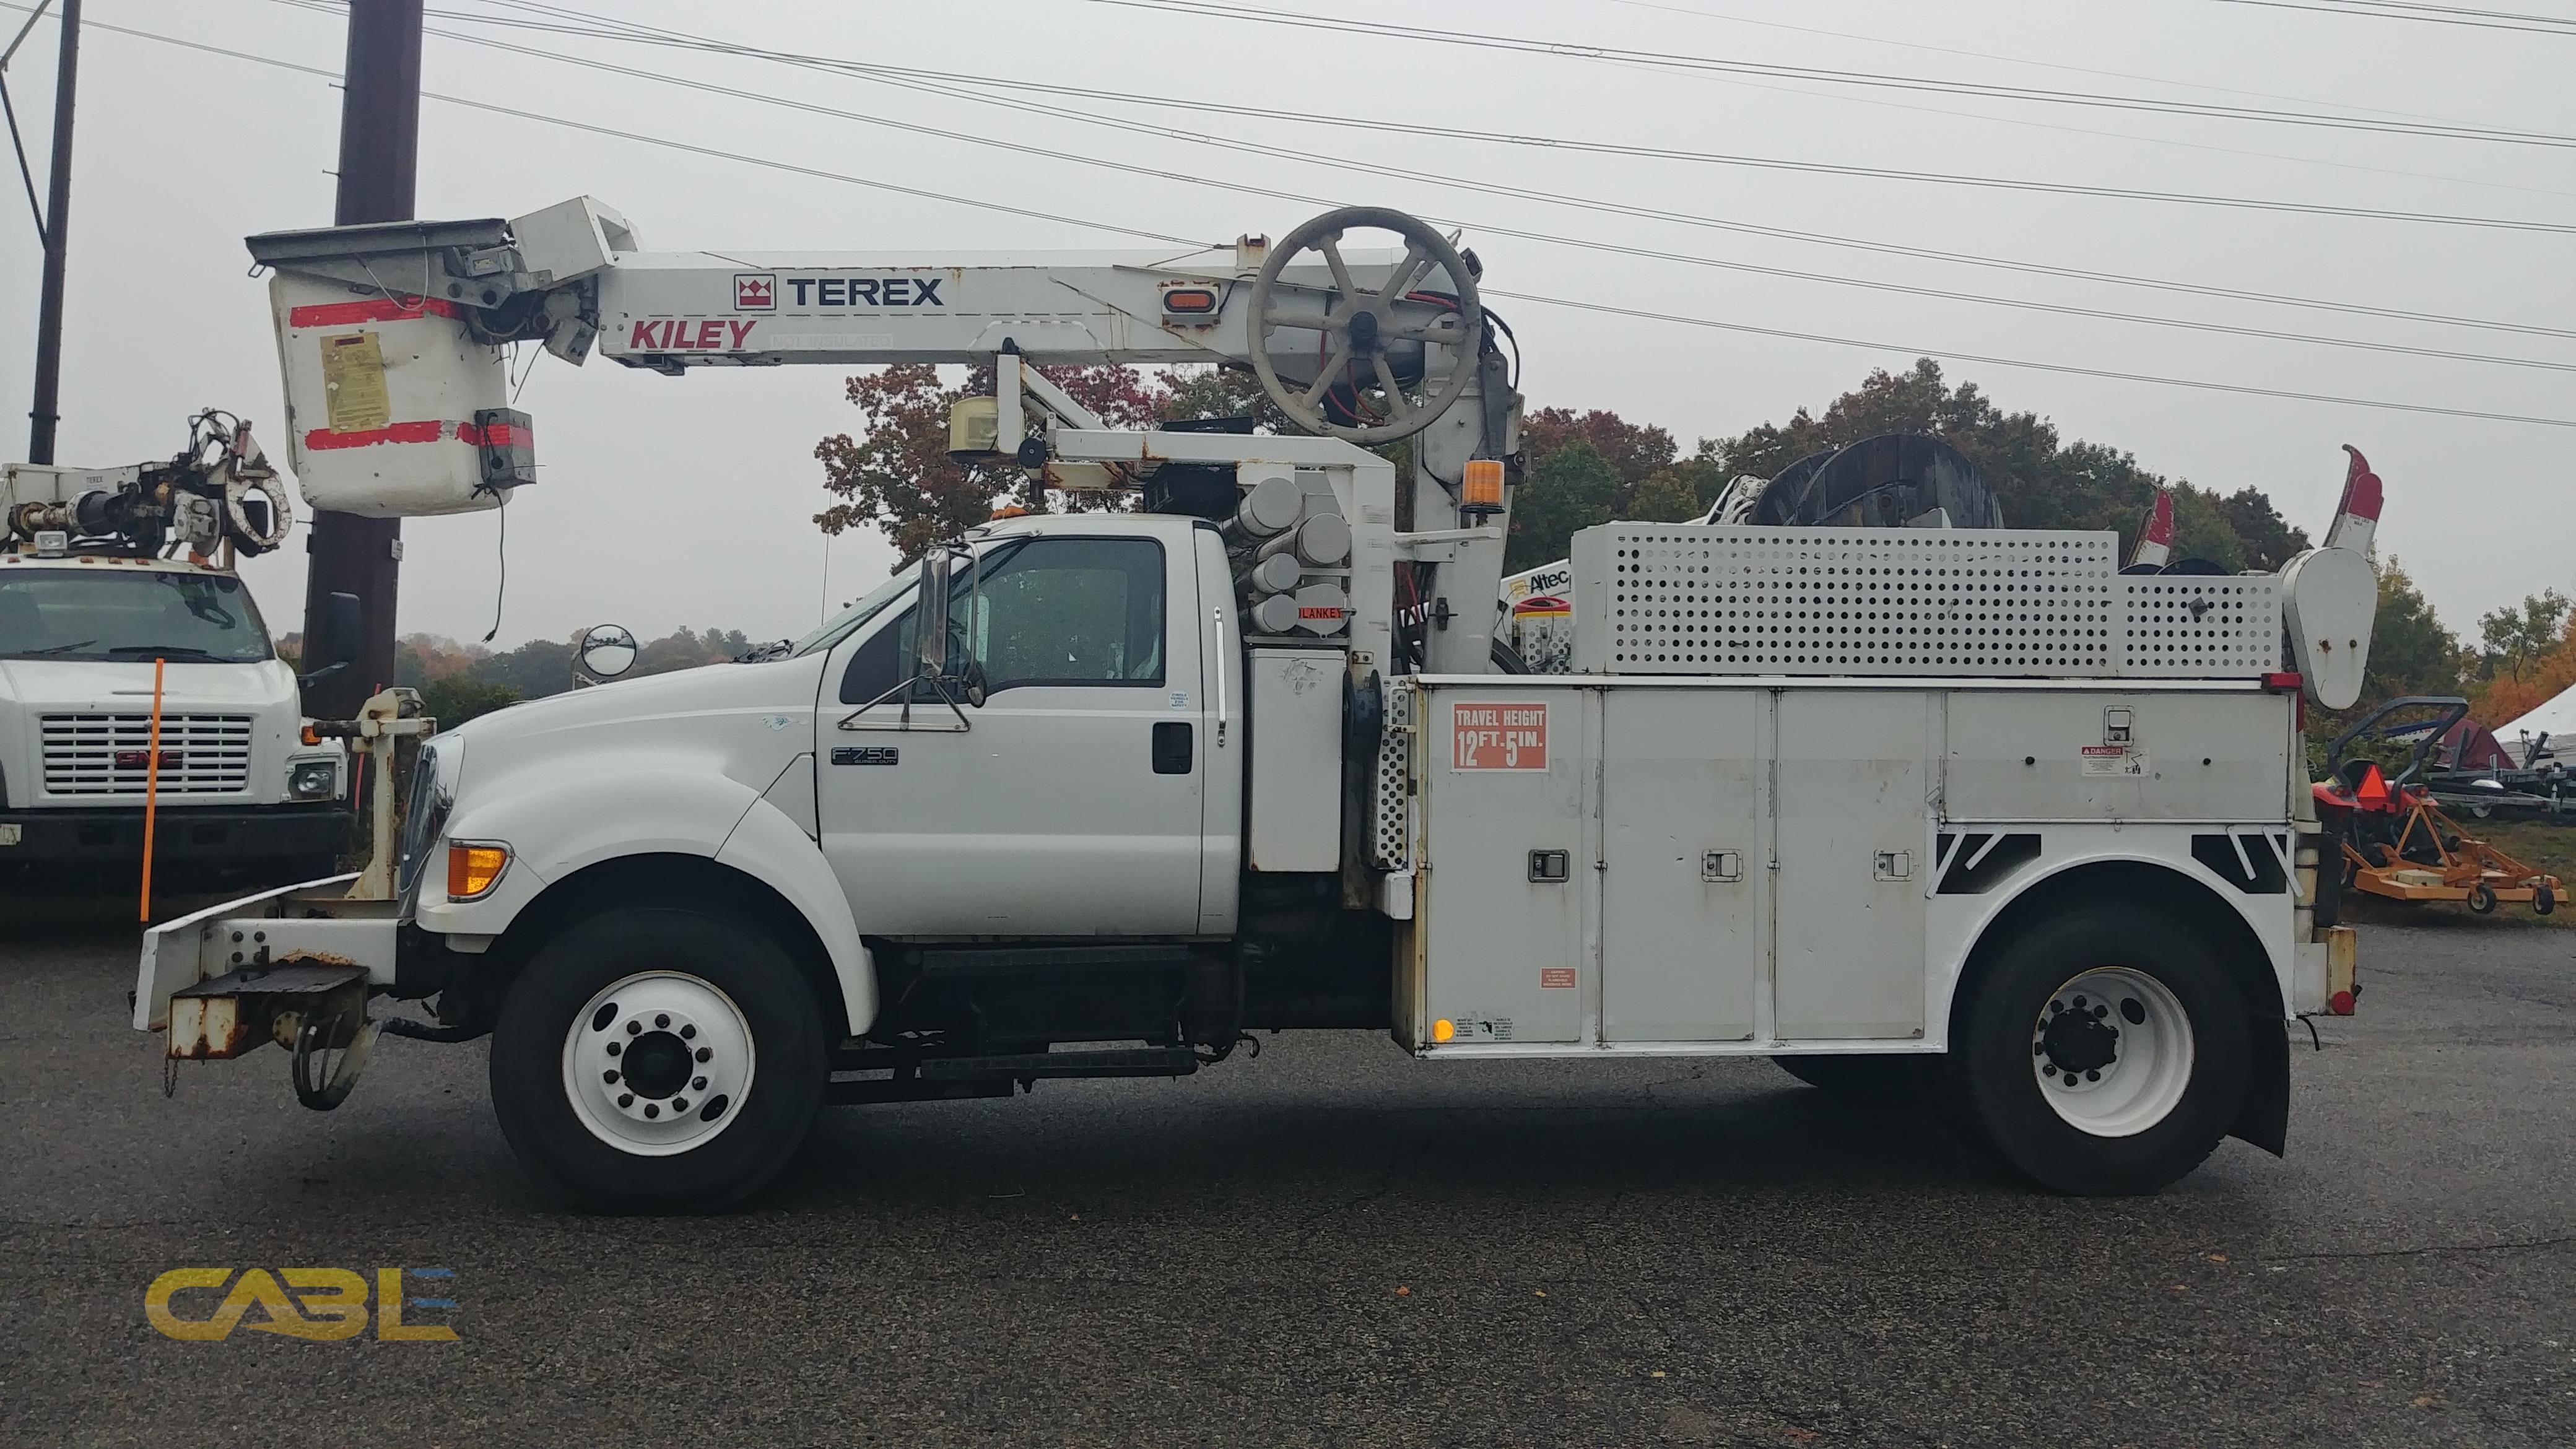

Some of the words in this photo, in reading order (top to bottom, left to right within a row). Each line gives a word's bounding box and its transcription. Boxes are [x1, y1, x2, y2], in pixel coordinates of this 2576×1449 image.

[787, 279, 944, 306] TEREX
[630, 320, 757, 348] KILEY
[773, 336, 803, 347] NOT
[809, 336, 890, 347] INSULATED
[1531, 571, 1569, 594] Altec
[1456, 710, 1499, 726] TRAVEL
[1503, 710, 1545, 726] HEIGHT
